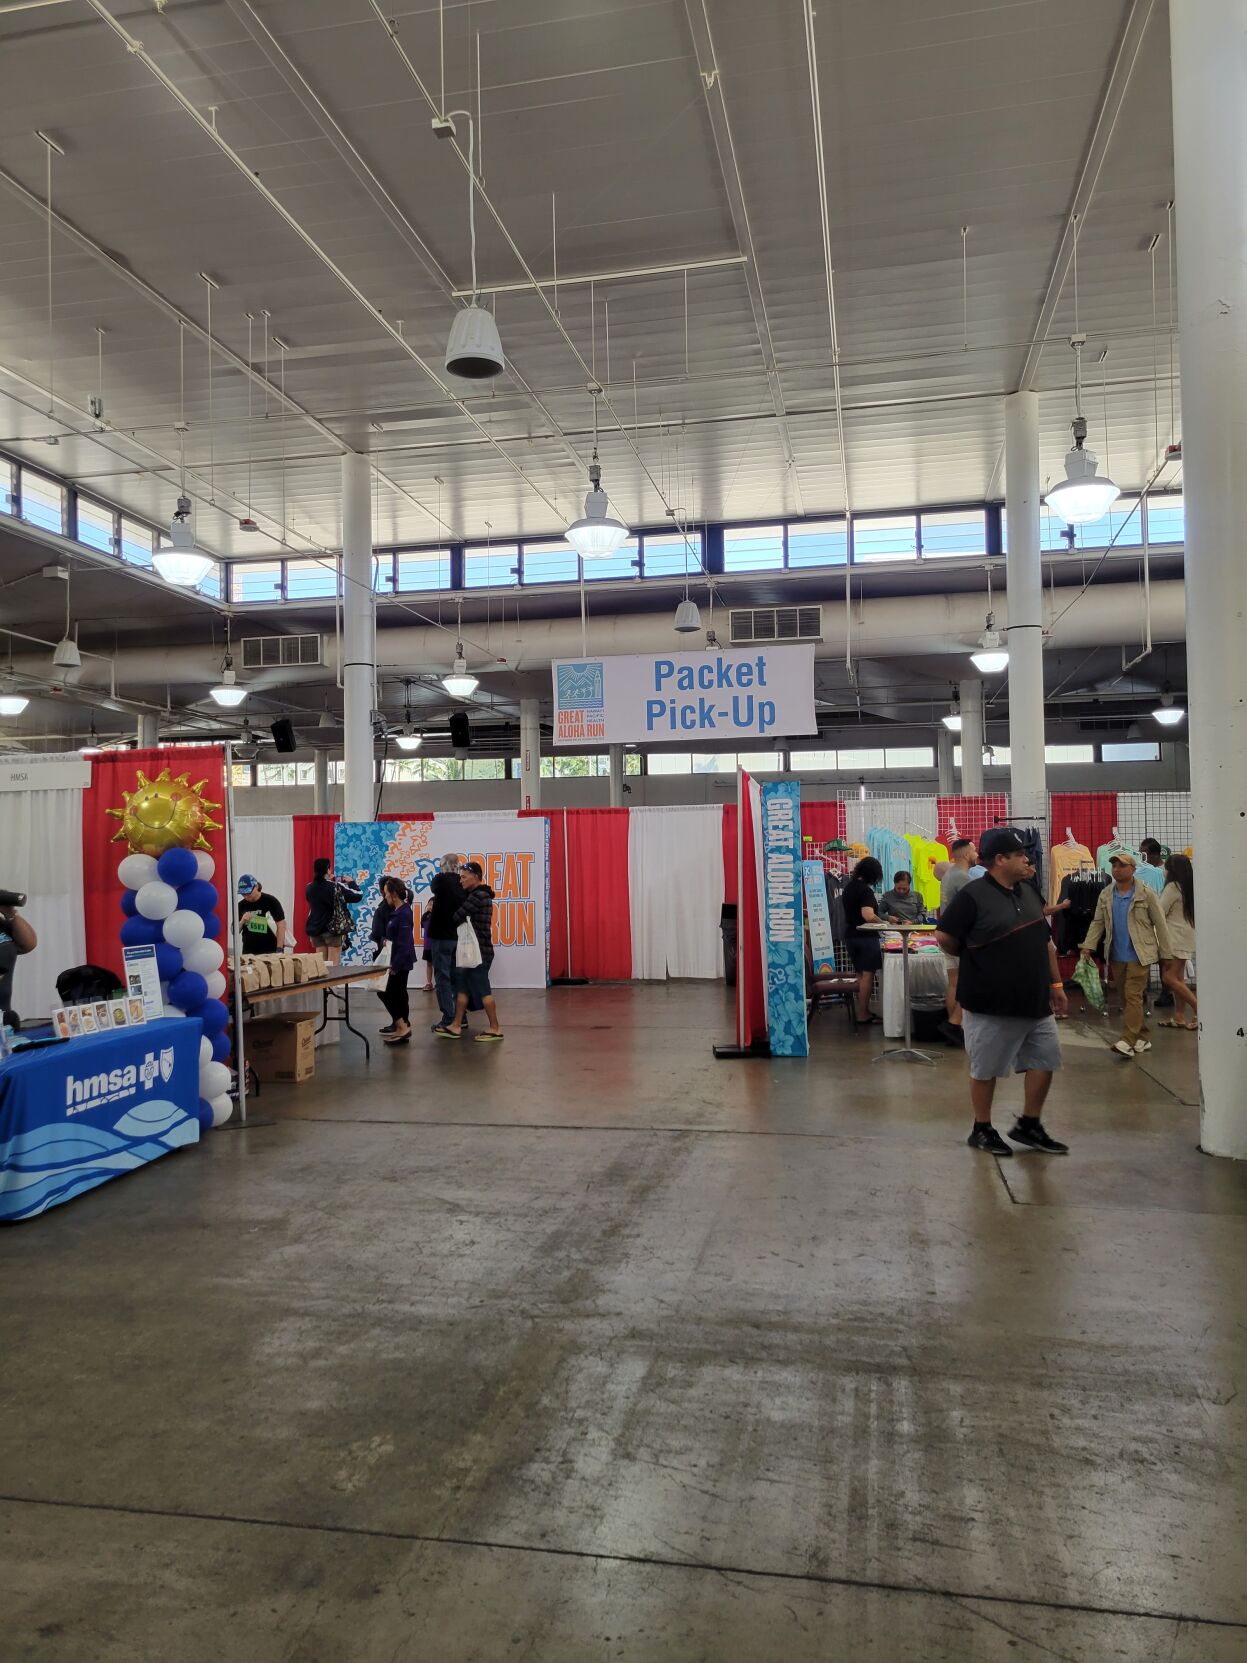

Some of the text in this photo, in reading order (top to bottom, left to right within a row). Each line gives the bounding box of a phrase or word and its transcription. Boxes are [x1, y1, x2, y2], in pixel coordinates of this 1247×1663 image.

[655, 656, 766, 691] Packet
[558, 710, 584, 724] GREAT
[558, 723, 604, 738] ALOHA RUN
[647, 695, 775, 733] Pick-Up
[10, 773, 28, 781] HMSA
[767, 798, 795, 941] GREAT ALOHA RUN
[66, 1065, 137, 1106] hmsa
